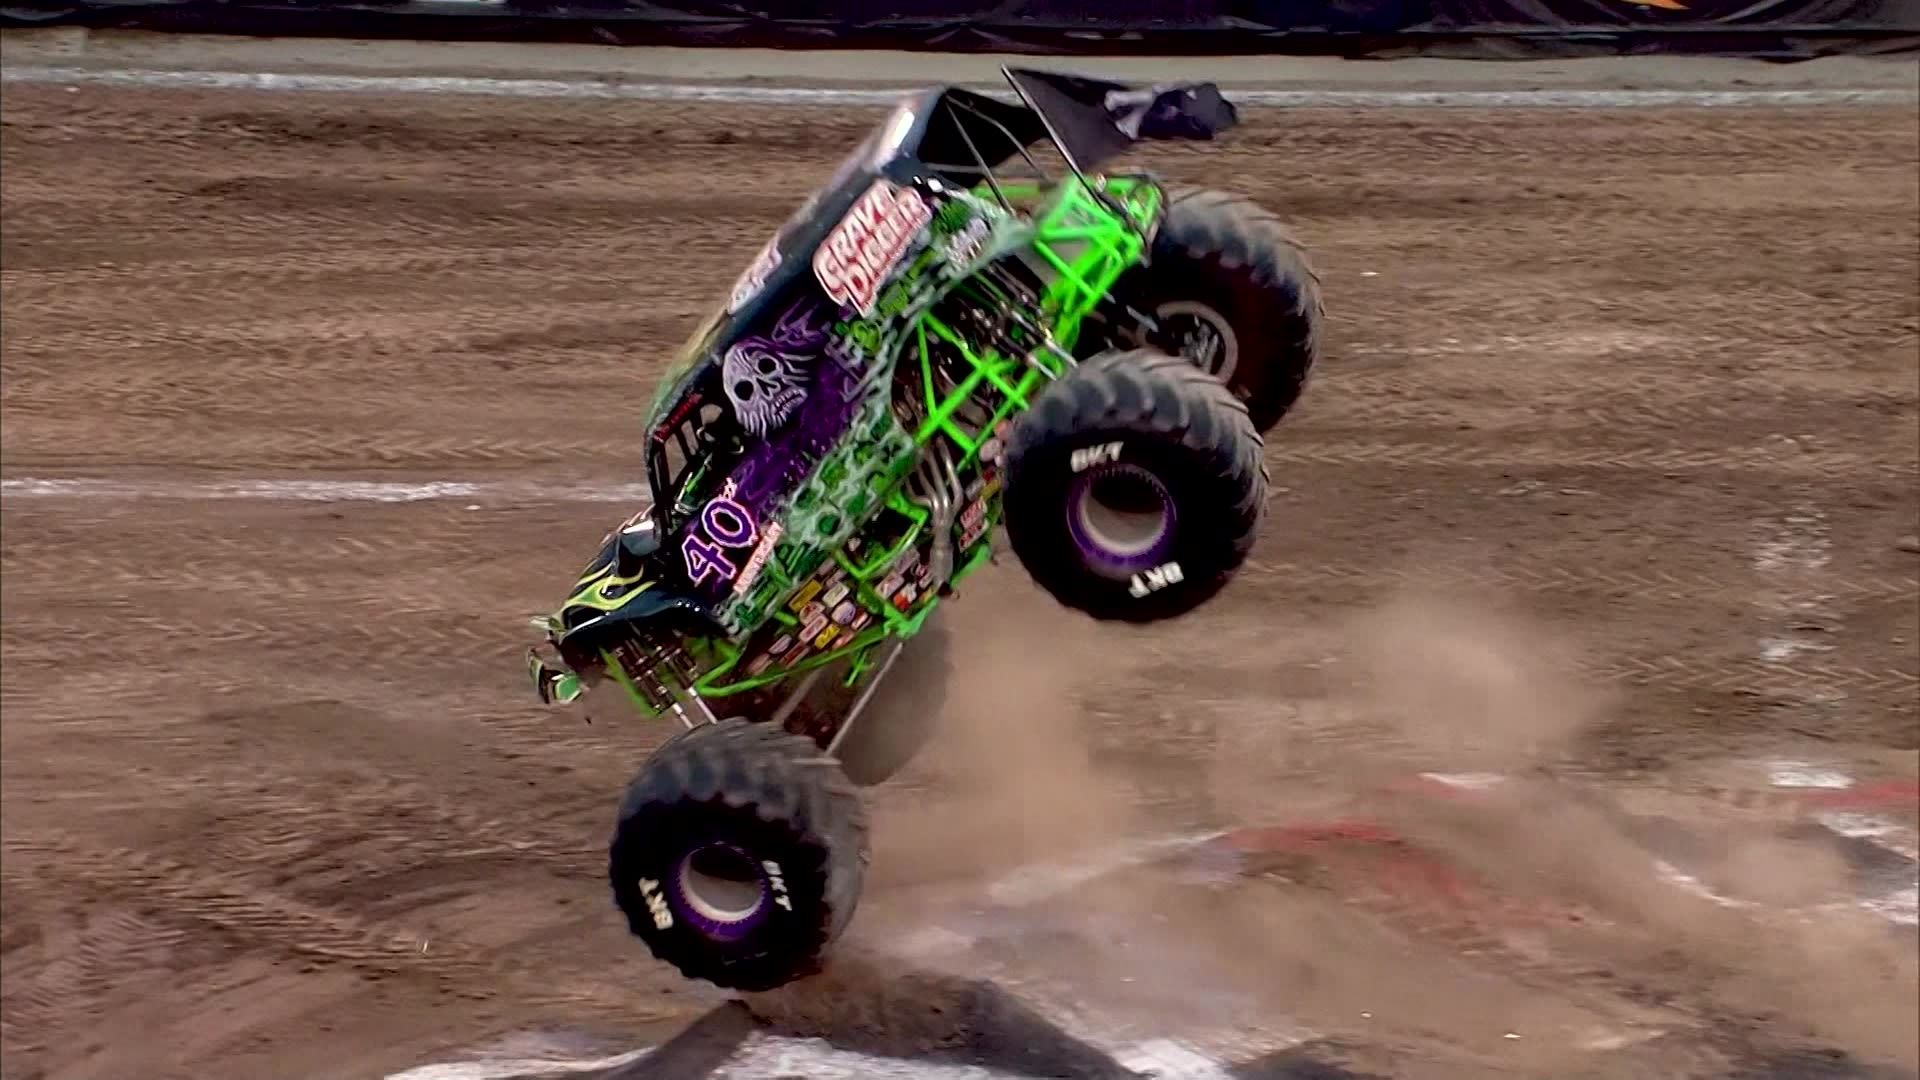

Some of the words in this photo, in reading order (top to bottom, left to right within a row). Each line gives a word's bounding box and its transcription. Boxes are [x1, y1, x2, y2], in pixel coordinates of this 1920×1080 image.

[813, 178, 897, 306] GRAVE
[1071, 441, 1124, 473] BKT
[1128, 561, 1184, 598] BKT
[638, 876, 674, 929] BKT
[760, 860, 792, 911] BKT
